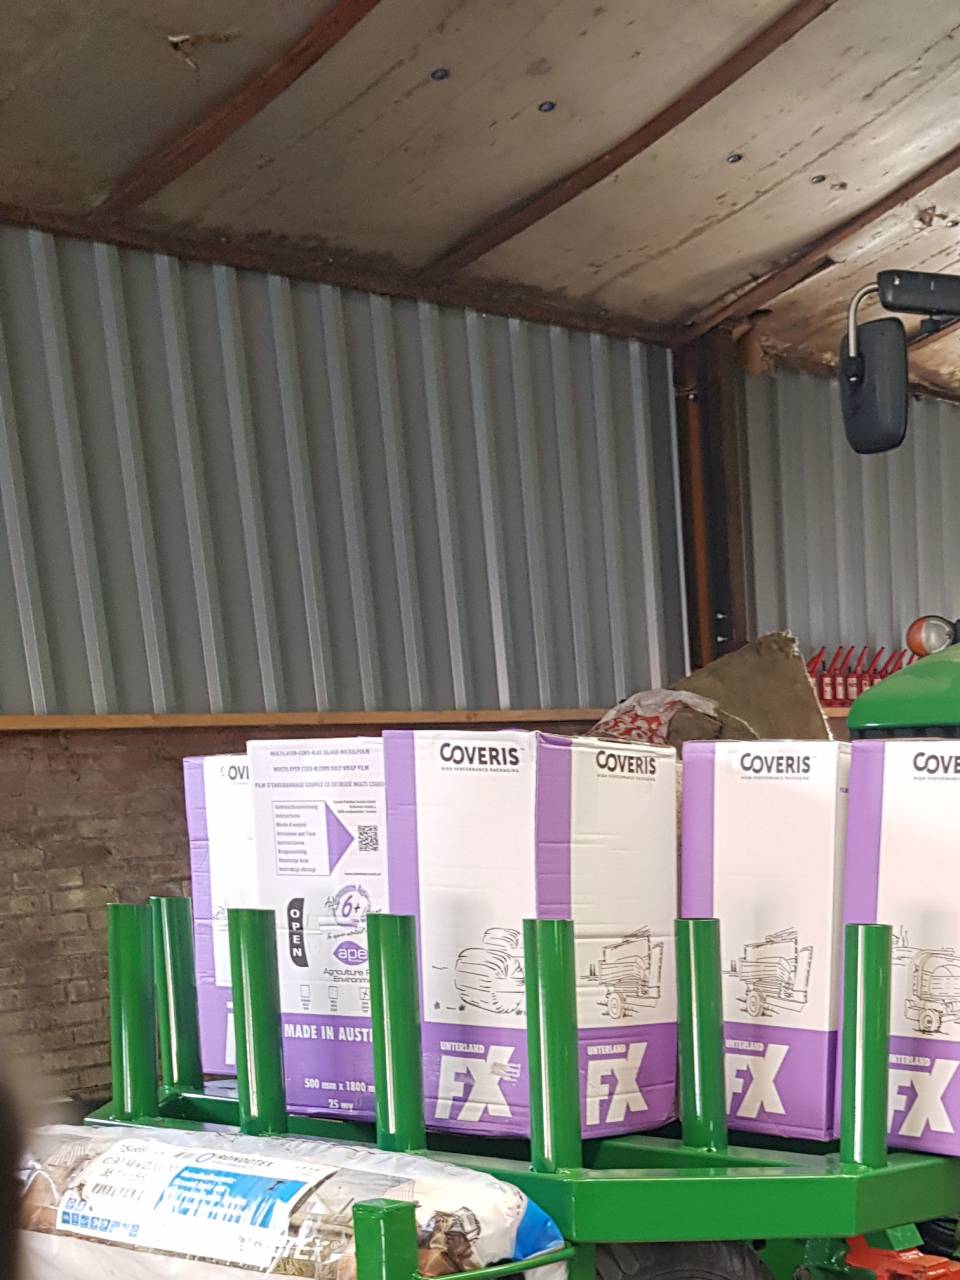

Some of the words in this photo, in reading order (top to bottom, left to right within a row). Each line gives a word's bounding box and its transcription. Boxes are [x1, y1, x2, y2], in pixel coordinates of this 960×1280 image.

[439, 742, 520, 766] COVERIS
[595, 750, 657, 775] COVERIS
[740, 752, 811, 775] COVERIS
[289, 908, 304, 957] OPEN
[284, 1023, 317, 1039] MADE
[320, 1025, 335, 1040] IN
[439, 1040, 486, 1054] UNTERLAND
[586, 1043, 627, 1056] UNTERLAND
[304, 1078, 320, 1089] 500
[345, 1081, 367, 1092] 1800
[434, 1044, 516, 1123] FX
[585, 1041, 649, 1126] FX
[725, 1043, 790, 1119] FX
[887, 1058, 960, 1138] FX
